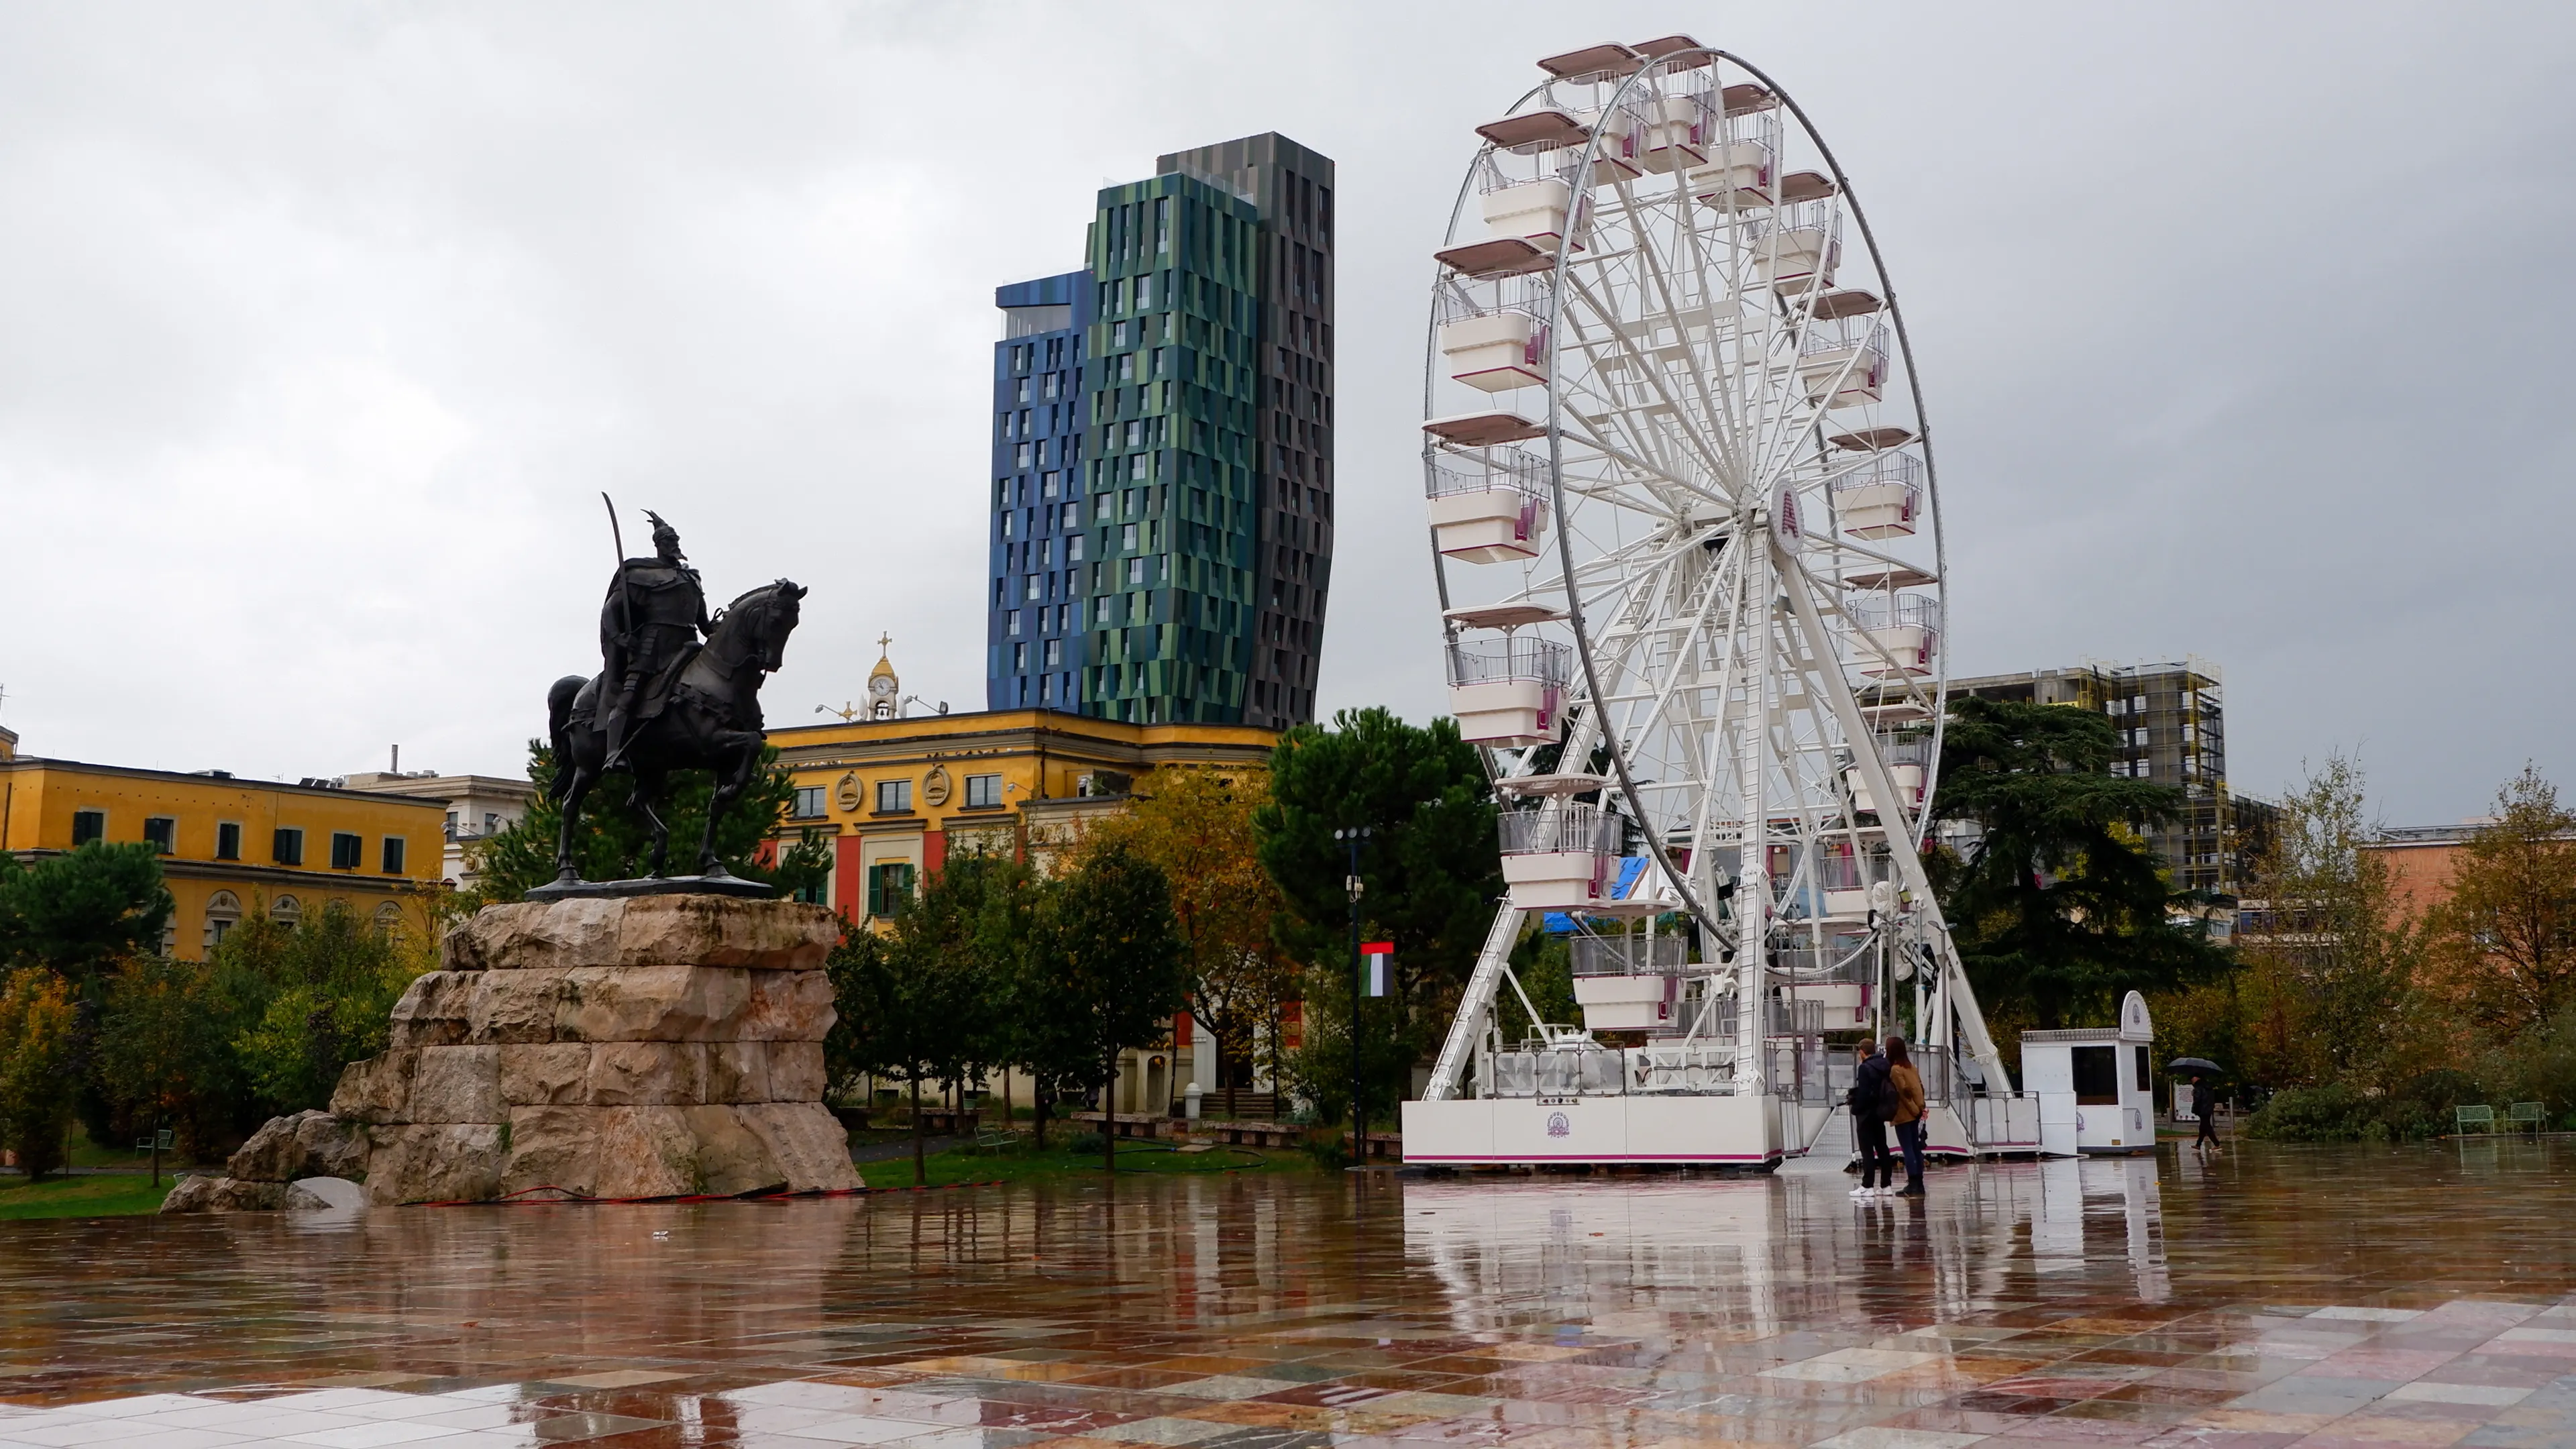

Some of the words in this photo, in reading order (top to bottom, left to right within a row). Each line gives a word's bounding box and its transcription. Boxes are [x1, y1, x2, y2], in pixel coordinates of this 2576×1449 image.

[1643, 125, 1649, 137] 12
[1586, 197, 1591, 209] 13
[1540, 502, 1546, 513] 15
[1782, 490, 1799, 538] A
[1561, 688, 1567, 700] 16
[1611, 857, 1617, 867] 17
